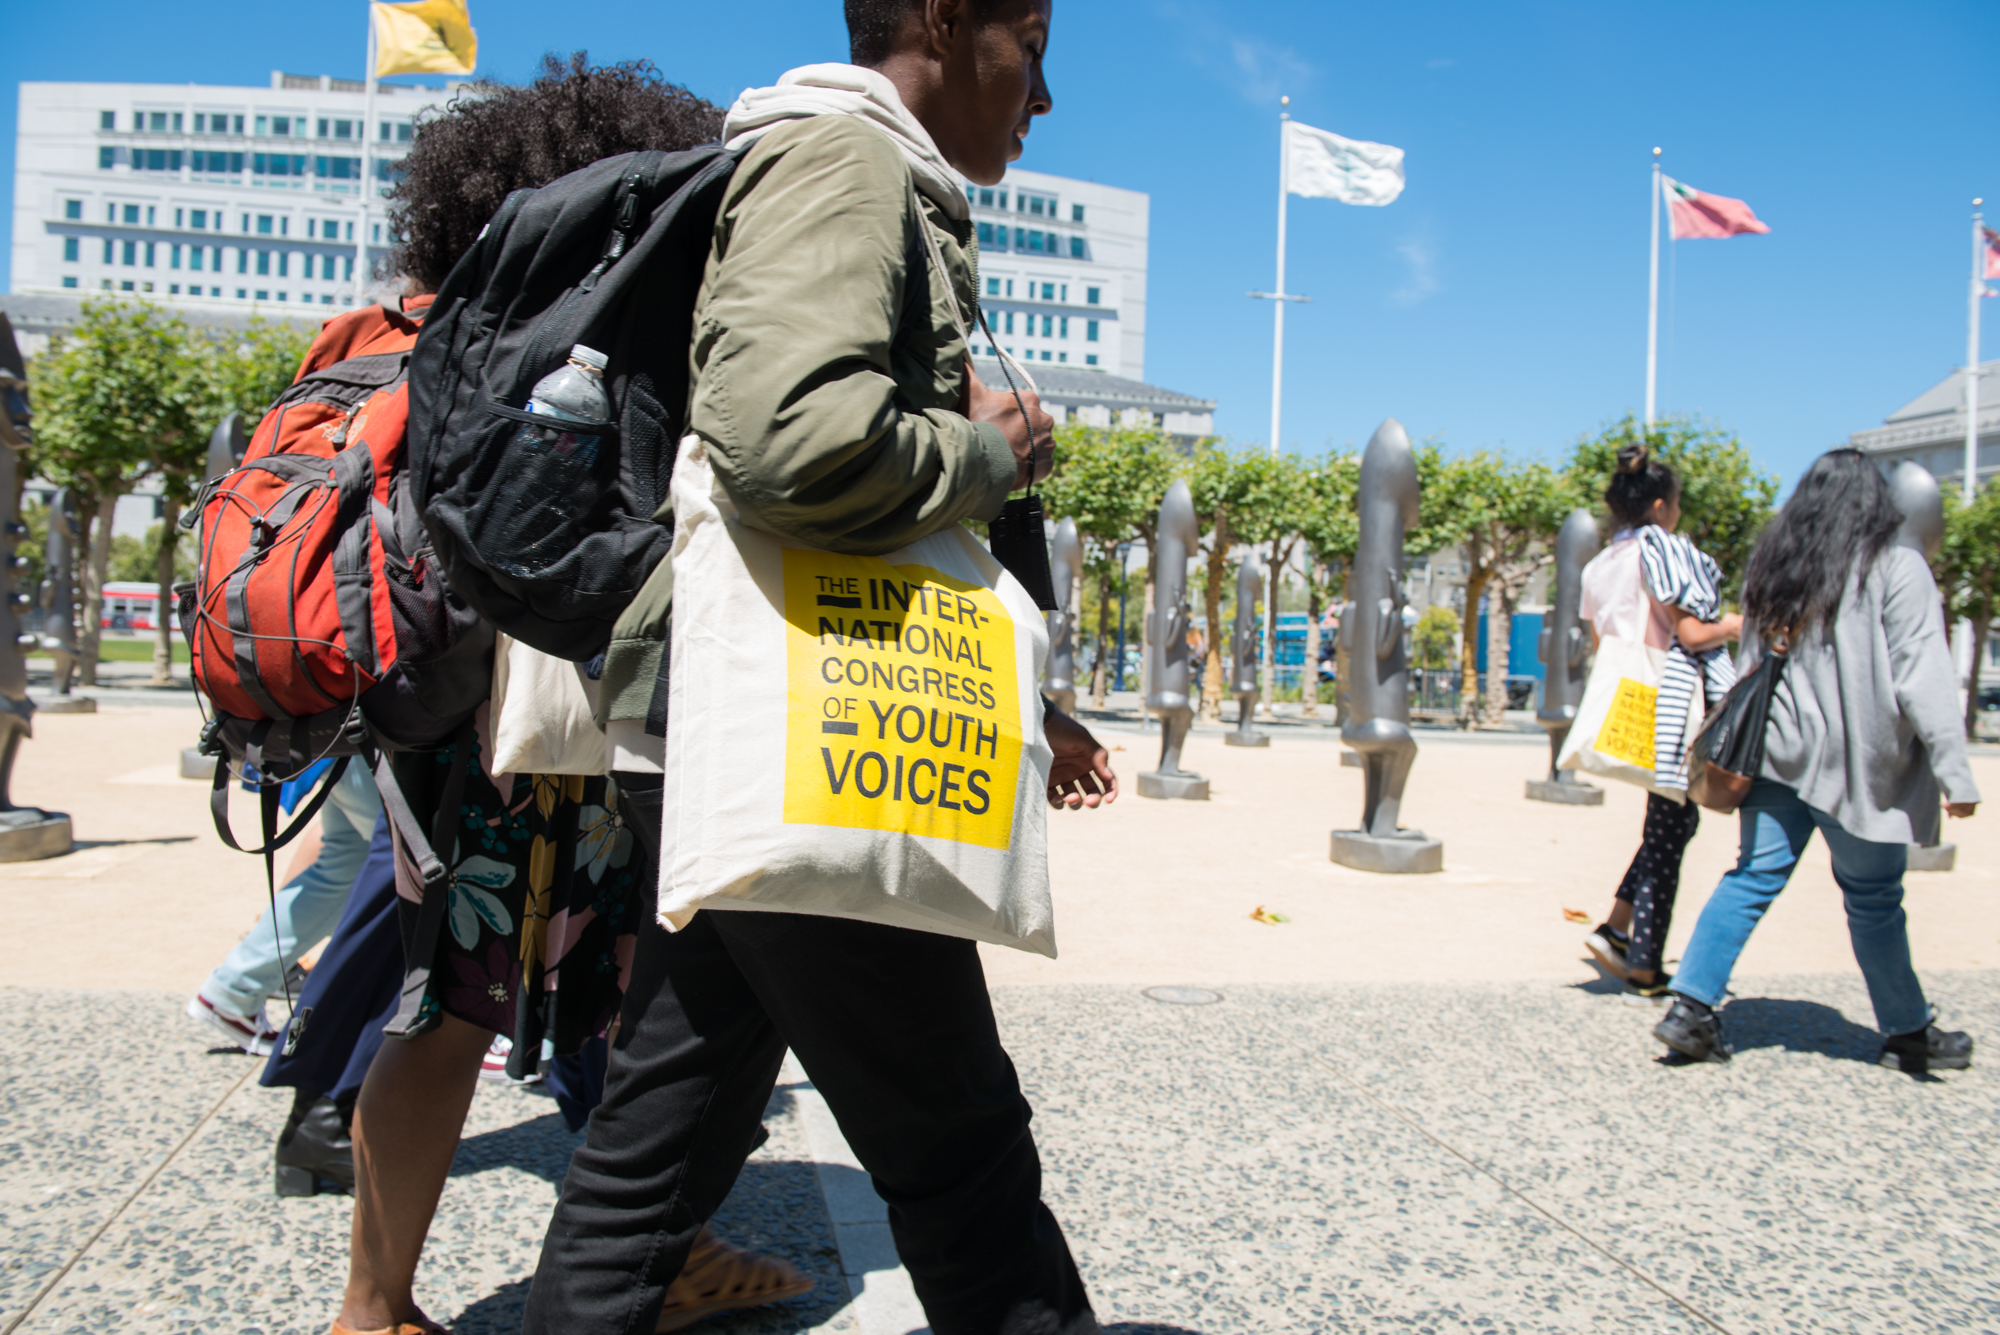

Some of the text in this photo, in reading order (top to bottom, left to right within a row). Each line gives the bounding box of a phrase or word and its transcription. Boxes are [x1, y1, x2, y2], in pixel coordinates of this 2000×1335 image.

[815, 576, 989, 629] THE INTER-
[818, 616, 993, 673] NATIONAL
[821, 656, 996, 710] CONGRESS
[823, 696, 998, 759] OF YOUTH
[1624, 725, 1653, 744] YOUT
[821, 747, 991, 815] VOICES
